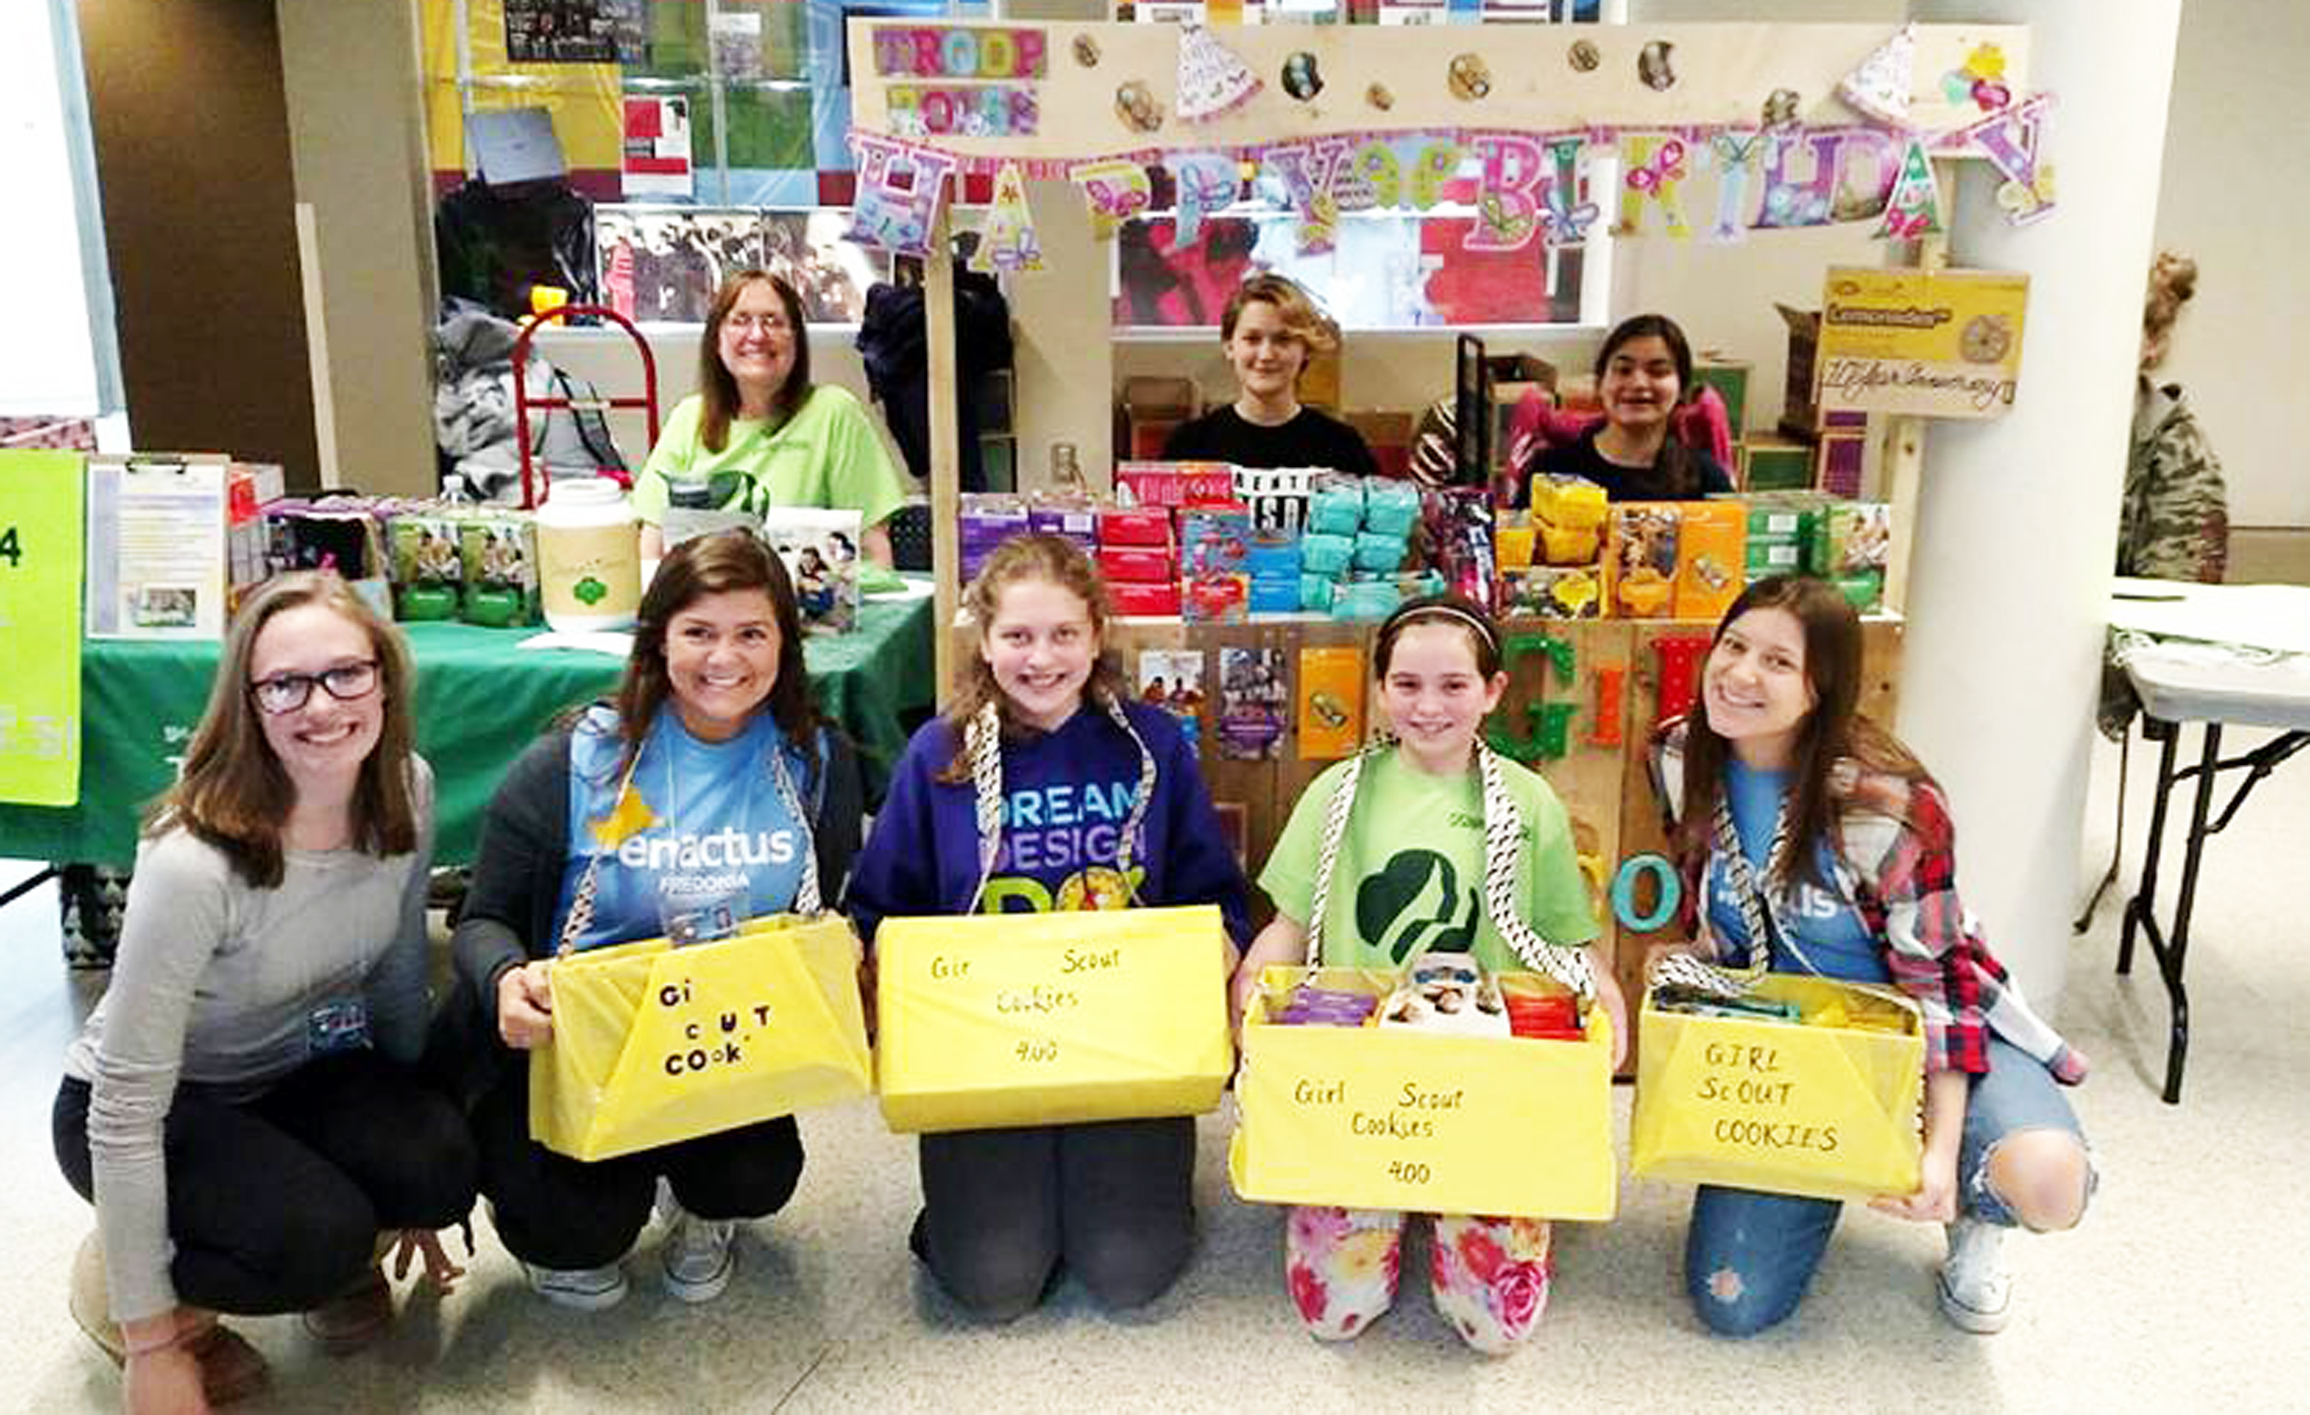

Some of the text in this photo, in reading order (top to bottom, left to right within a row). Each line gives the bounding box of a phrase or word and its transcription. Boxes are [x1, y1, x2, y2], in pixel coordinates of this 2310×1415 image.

[872, 28, 1046, 77] TROOP
[846, 95, 2058, 271] HAPPY BIRTHDAY
[618, 826, 795, 869] enactus
[659, 871, 750, 894] FREDONIA
[1062, 947, 1120, 974] Scout
[1705, 1042, 1778, 1073] GIRL
[1294, 1079, 1464, 1109] Girl Scout
[1351, 1110, 1433, 1140] Cookies
[1715, 1118, 1838, 1151] COOKIES
